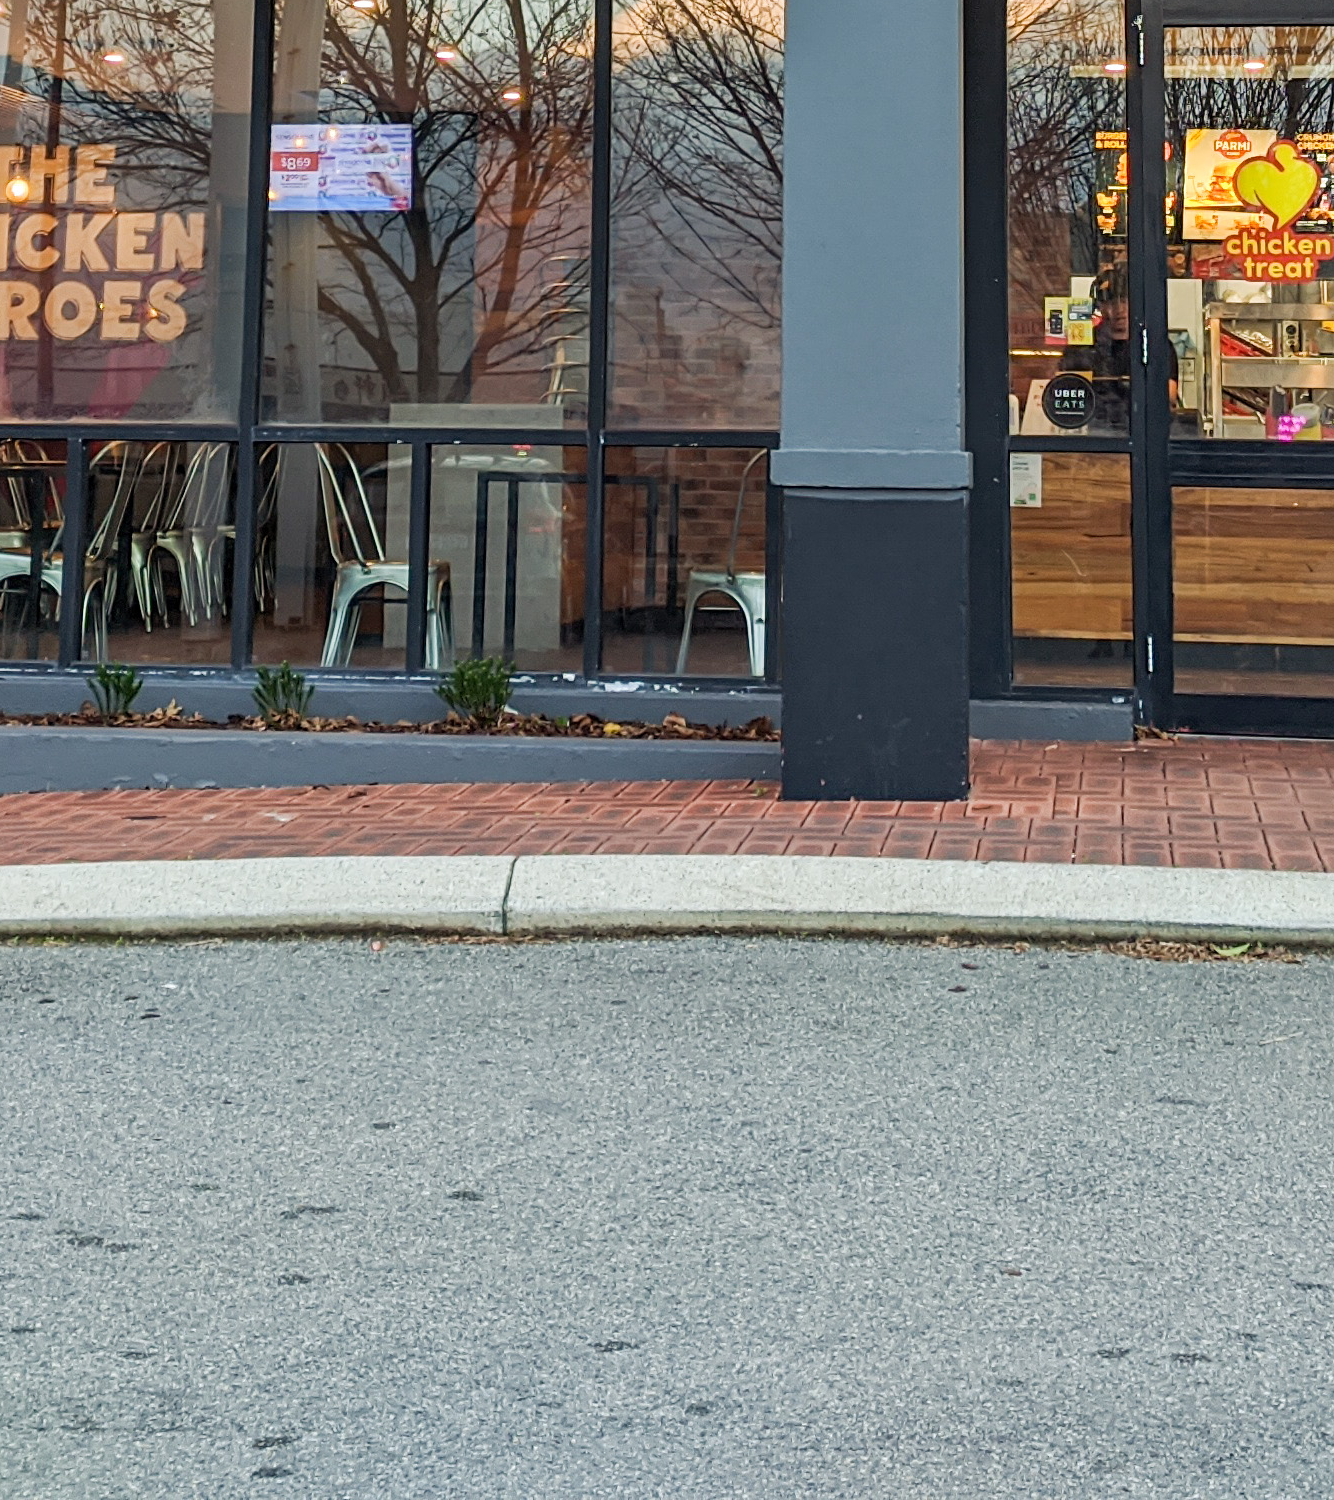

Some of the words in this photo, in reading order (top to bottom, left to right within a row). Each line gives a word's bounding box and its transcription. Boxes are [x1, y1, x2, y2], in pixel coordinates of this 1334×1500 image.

[1215, 140, 1252, 151] PARMI
[1226, 231, 1331, 255] chicken
[1243, 256, 1314, 278] treat
[1054, 389, 1085, 398] UBER
[1054, 400, 1085, 409] EATS
